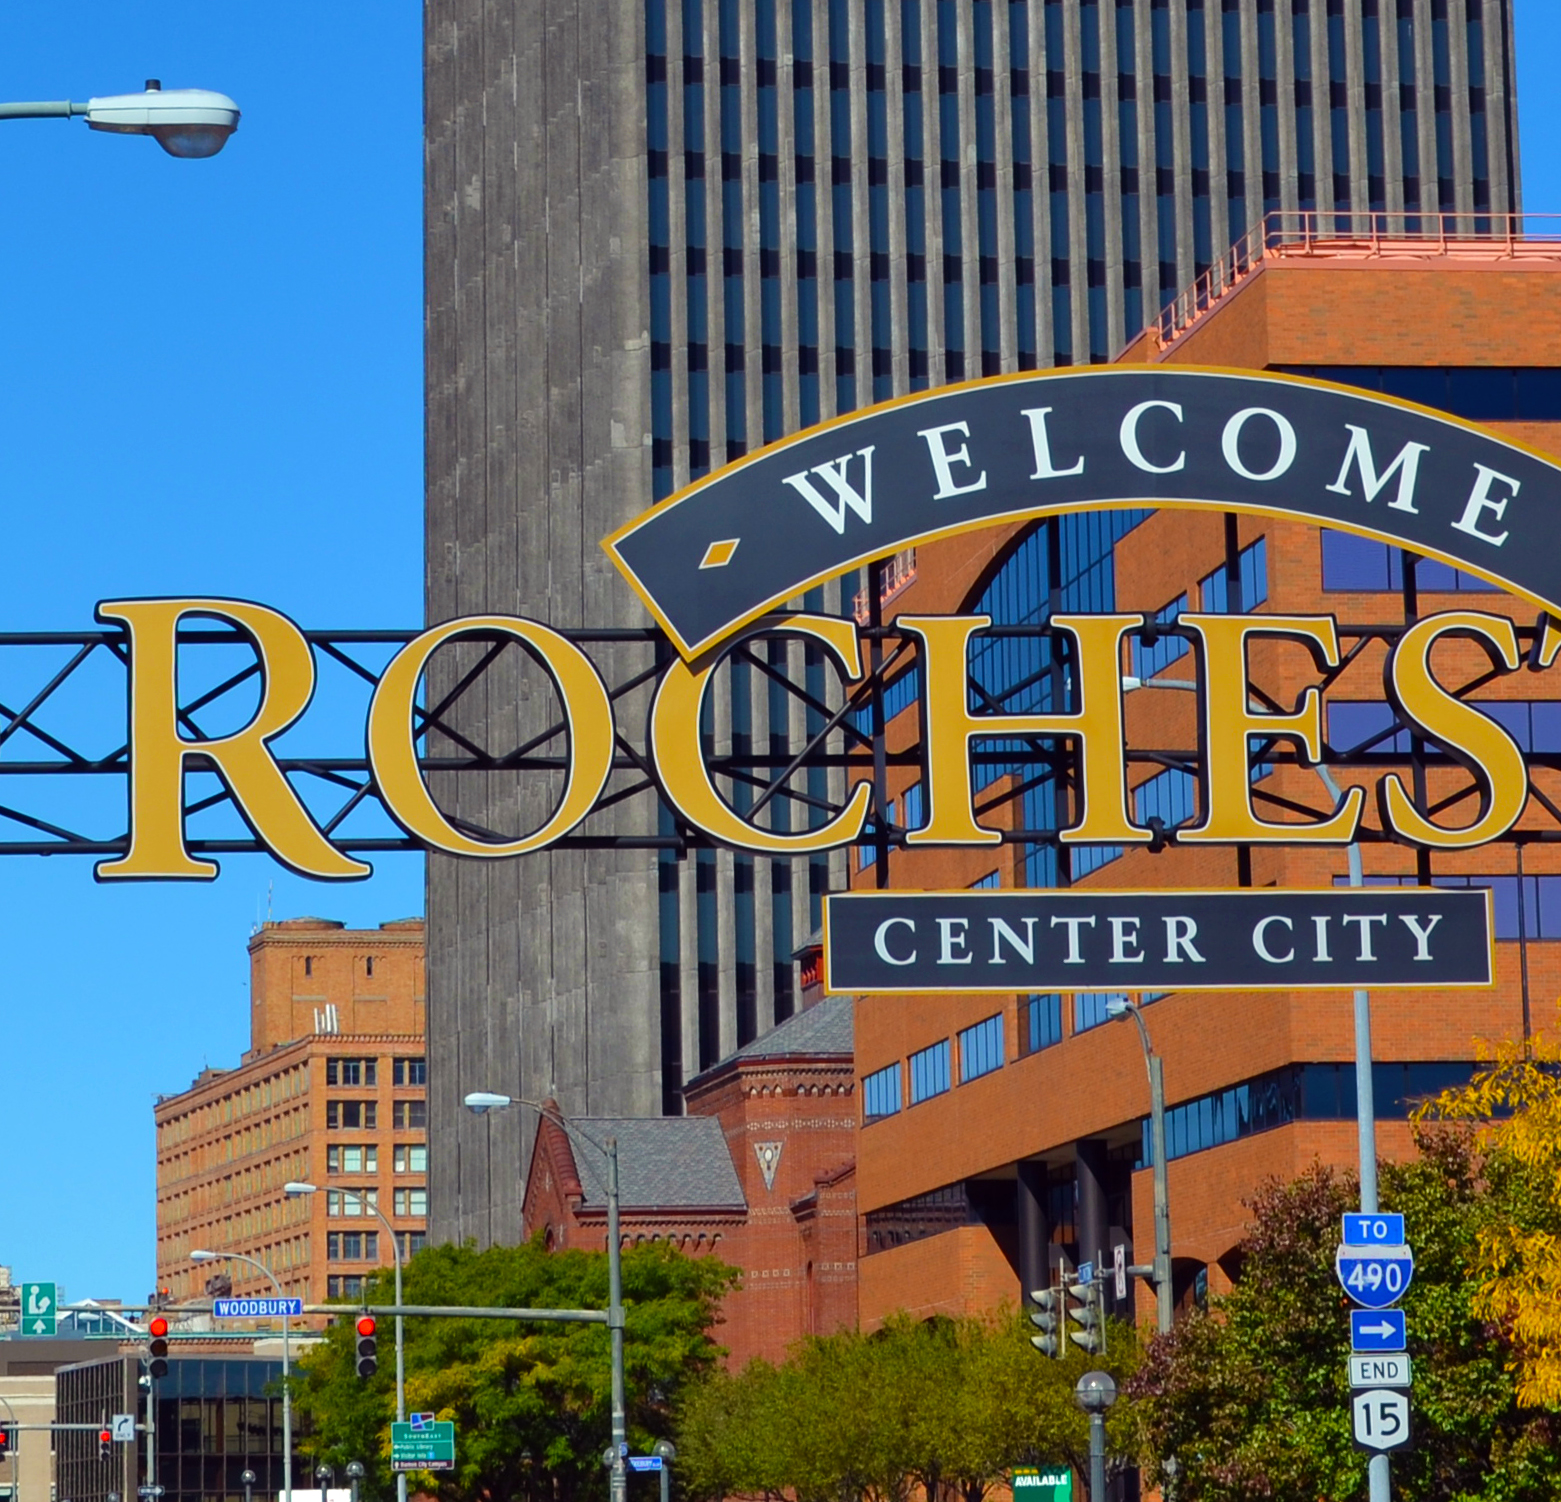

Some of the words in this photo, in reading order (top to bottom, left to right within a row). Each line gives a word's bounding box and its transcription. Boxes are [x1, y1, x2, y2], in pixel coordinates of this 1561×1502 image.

[783, 399, 1521, 546] WELCOME
[874, 916, 1206, 966] CENTER
[1251, 913, 1444, 964] CITY
[1358, 1220, 1388, 1239] TO
[1347, 1263, 1402, 1293] 490
[219, 1300, 296, 1315] WOODBURY
[1360, 1361, 1399, 1379] END
[1362, 1402, 1401, 1436] 15
[1015, 1474, 1068, 1487] AVAILABLE
